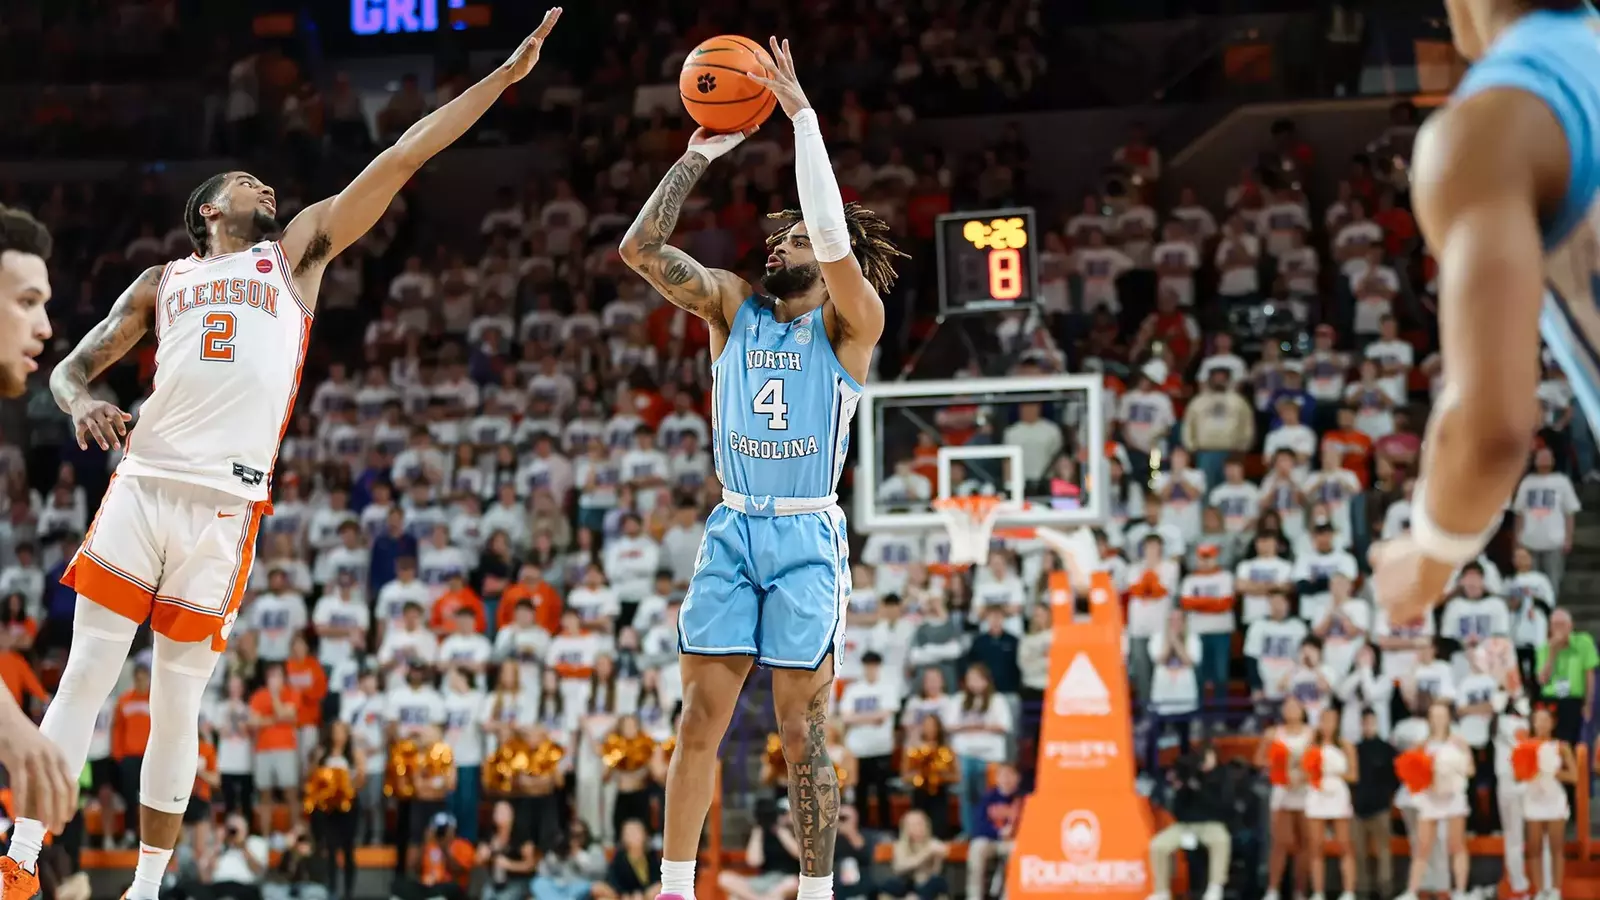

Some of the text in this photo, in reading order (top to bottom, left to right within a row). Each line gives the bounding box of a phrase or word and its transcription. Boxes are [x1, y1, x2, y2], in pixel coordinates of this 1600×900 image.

[963, 217, 1027, 249] 9:26
[988, 248, 1022, 300] 8
[164, 277, 279, 327] CLEMSON
[200, 310, 237, 362] 2
[746, 349, 802, 372] NORTH
[753, 377, 788, 430] 4
[729, 430, 819, 460] CAROLINA
